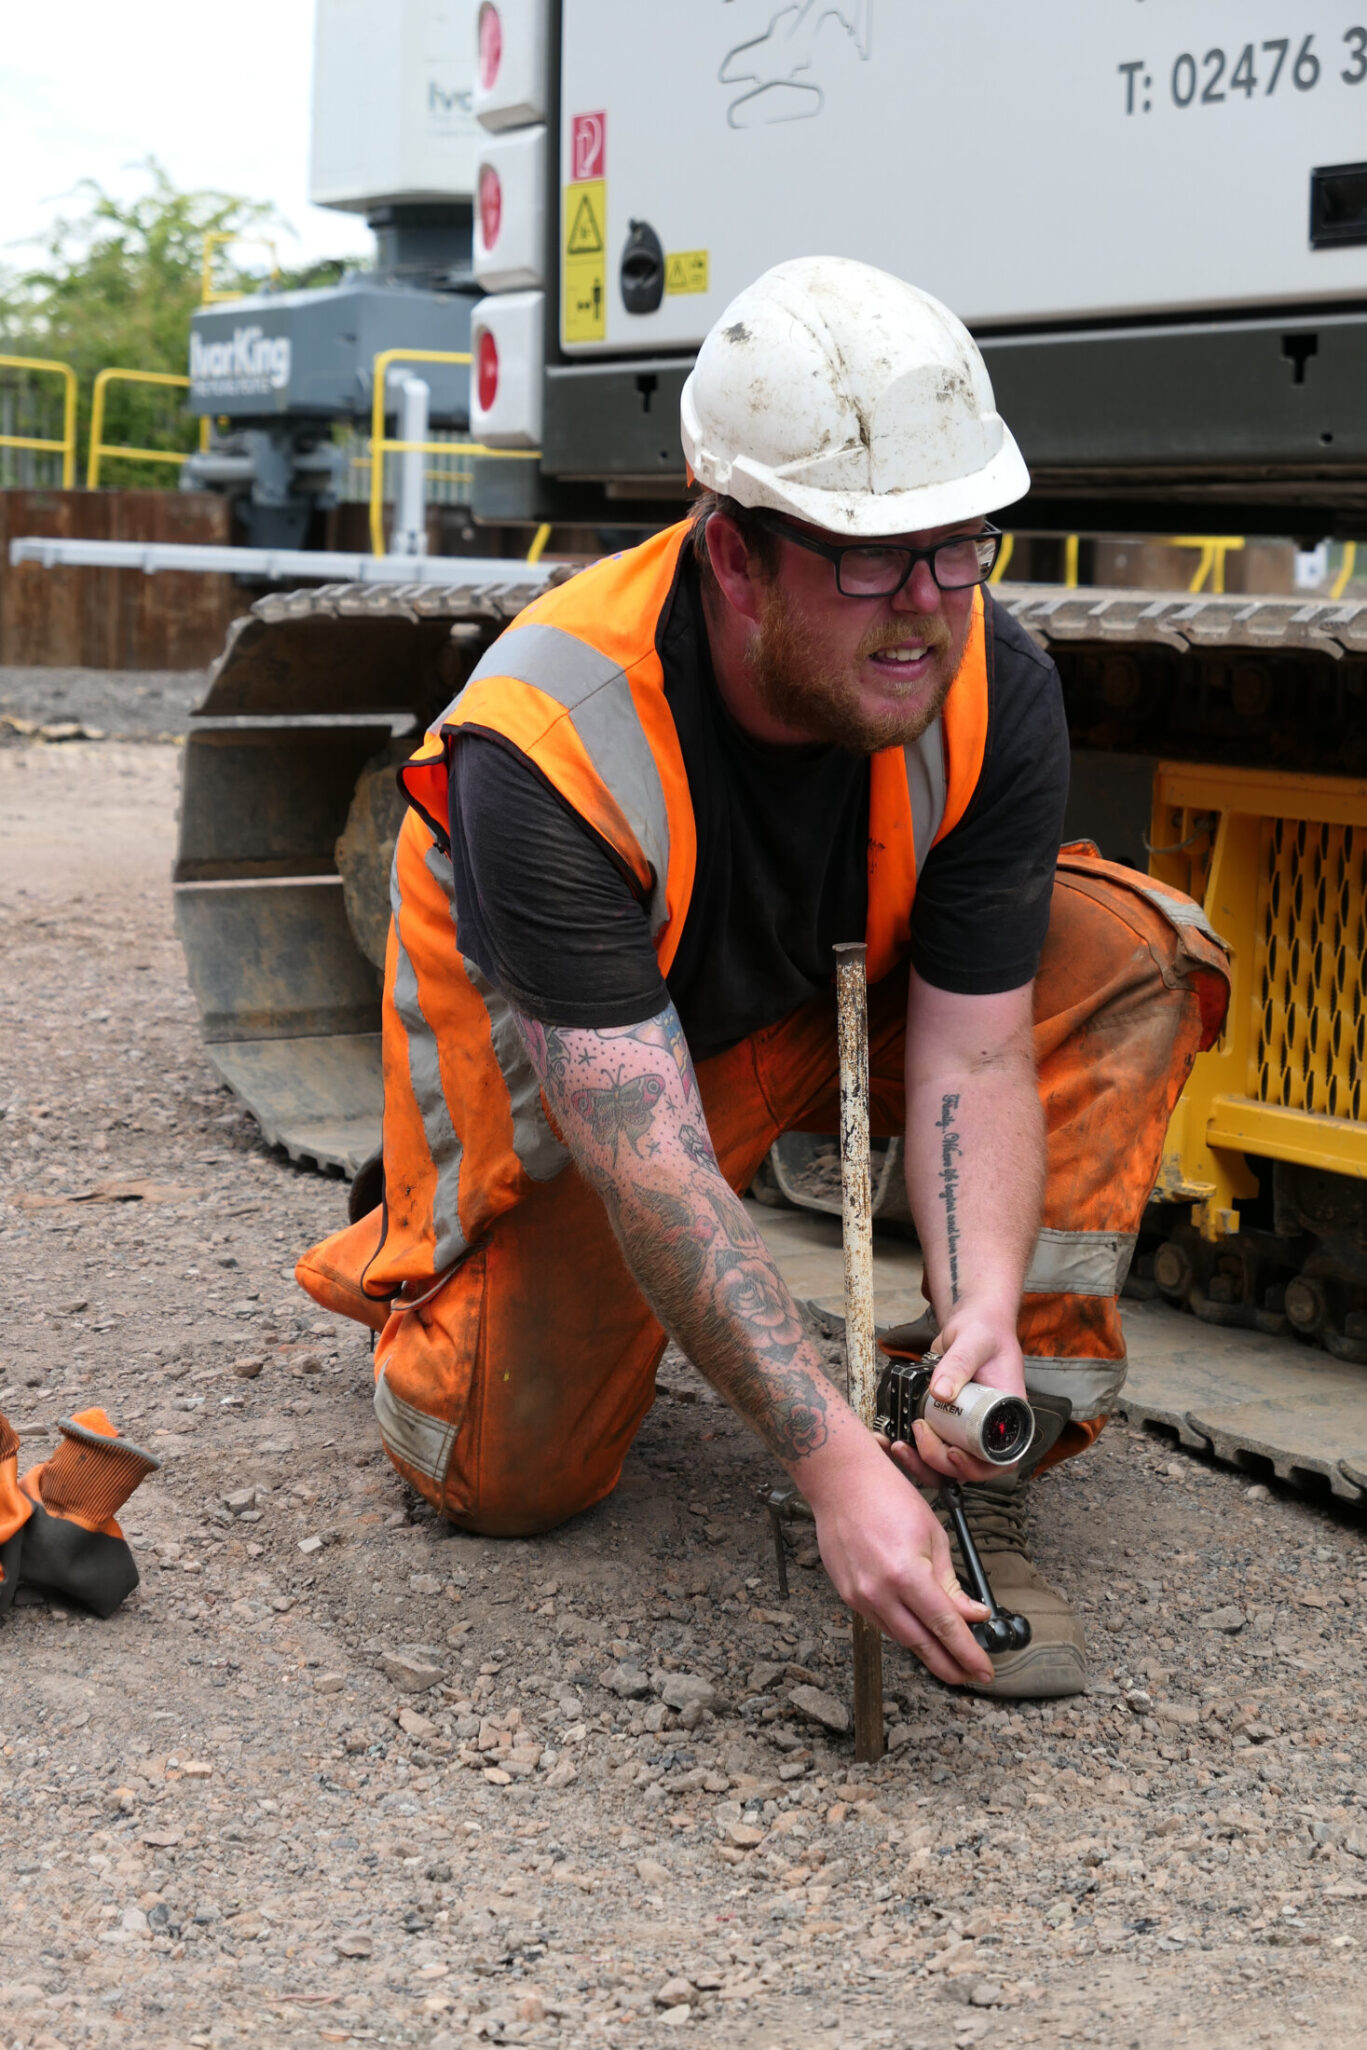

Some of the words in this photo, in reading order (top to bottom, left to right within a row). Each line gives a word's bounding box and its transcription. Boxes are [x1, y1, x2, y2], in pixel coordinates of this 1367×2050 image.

[1117, 60, 1152, 115] T:
[1171, 34, 1321, 109] 02476
[933, 1400, 964, 1416] GIKEN
